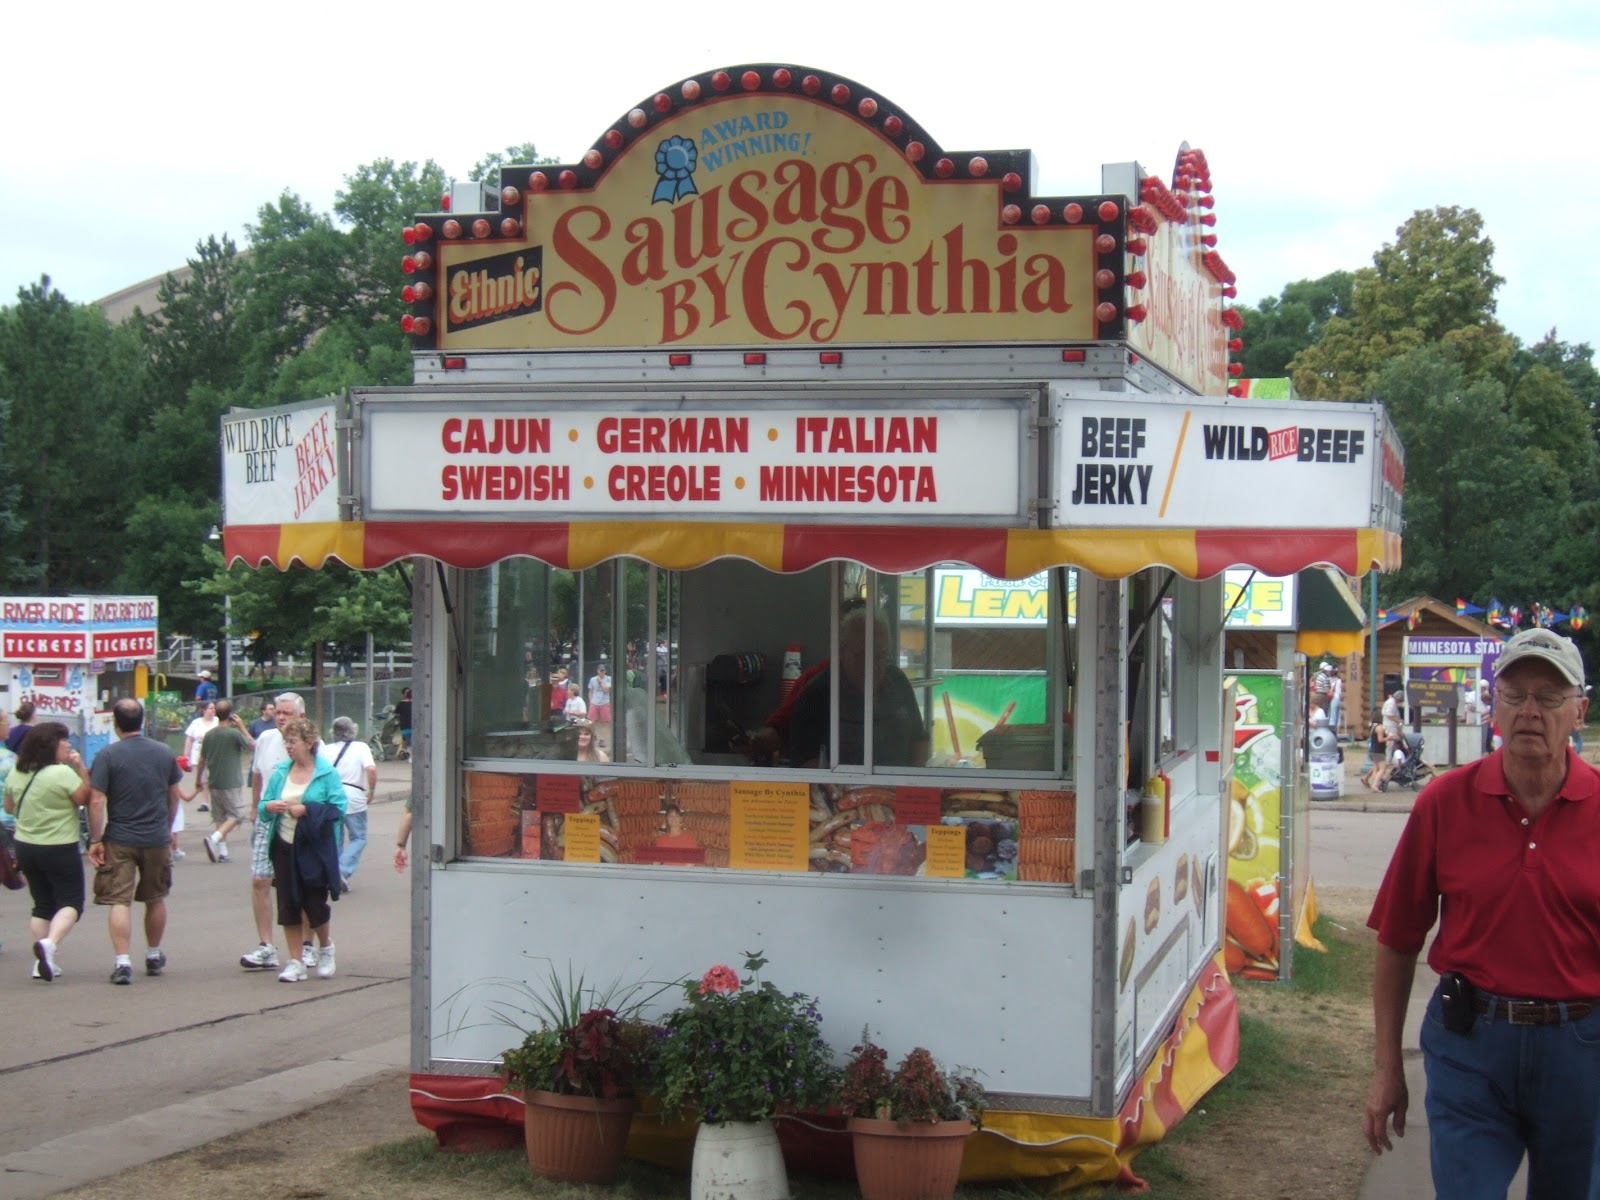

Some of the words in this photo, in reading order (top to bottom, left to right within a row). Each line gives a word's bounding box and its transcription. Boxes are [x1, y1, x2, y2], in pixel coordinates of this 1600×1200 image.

[701, 110, 789, 145] AWARD
[700, 131, 812, 173] WINNING!
[545, 154, 911, 336] Sausage
[450, 256, 541, 324] Ethnic
[656, 250, 744, 345] BY
[742, 223, 1073, 343] Cynthia
[224, 420, 259, 453] WILD
[261, 414, 293, 450] RICE
[295, 411, 328, 480] BEEF
[442, 418, 550, 454] CAJUN
[597, 417, 749, 454] GERMAN
[797, 417, 937, 453] ITALIAN
[1081, 417, 1146, 458] BEEF
[1204, 425, 1269, 461] WILD
[1268, 427, 1298, 460] RICE
[1298, 428, 1365, 464] BEEF
[246, 450, 277, 484] BEEF
[294, 440, 336, 520] JERKY
[442, 465, 570, 501] SWEDISH
[608, 465, 721, 502] CREOLE
[760, 465, 937, 503] MINNESOTA
[1072, 464, 1153, 505] JERKY
[4, 602, 46, 624] RIVER
[49, 602, 86, 624] RIDE
[93, 603, 118, 622] RIVER
[138, 601, 154, 621] RIDE
[6, 638, 84, 653] TICKETS
[94, 636, 154, 653] TICKETS
[1409, 641, 1471, 654] MINNESOTA
[1475, 641, 1504, 654] STAT
[734, 788, 762, 798] Sausage
[776, 789, 806, 798] Cynthia
